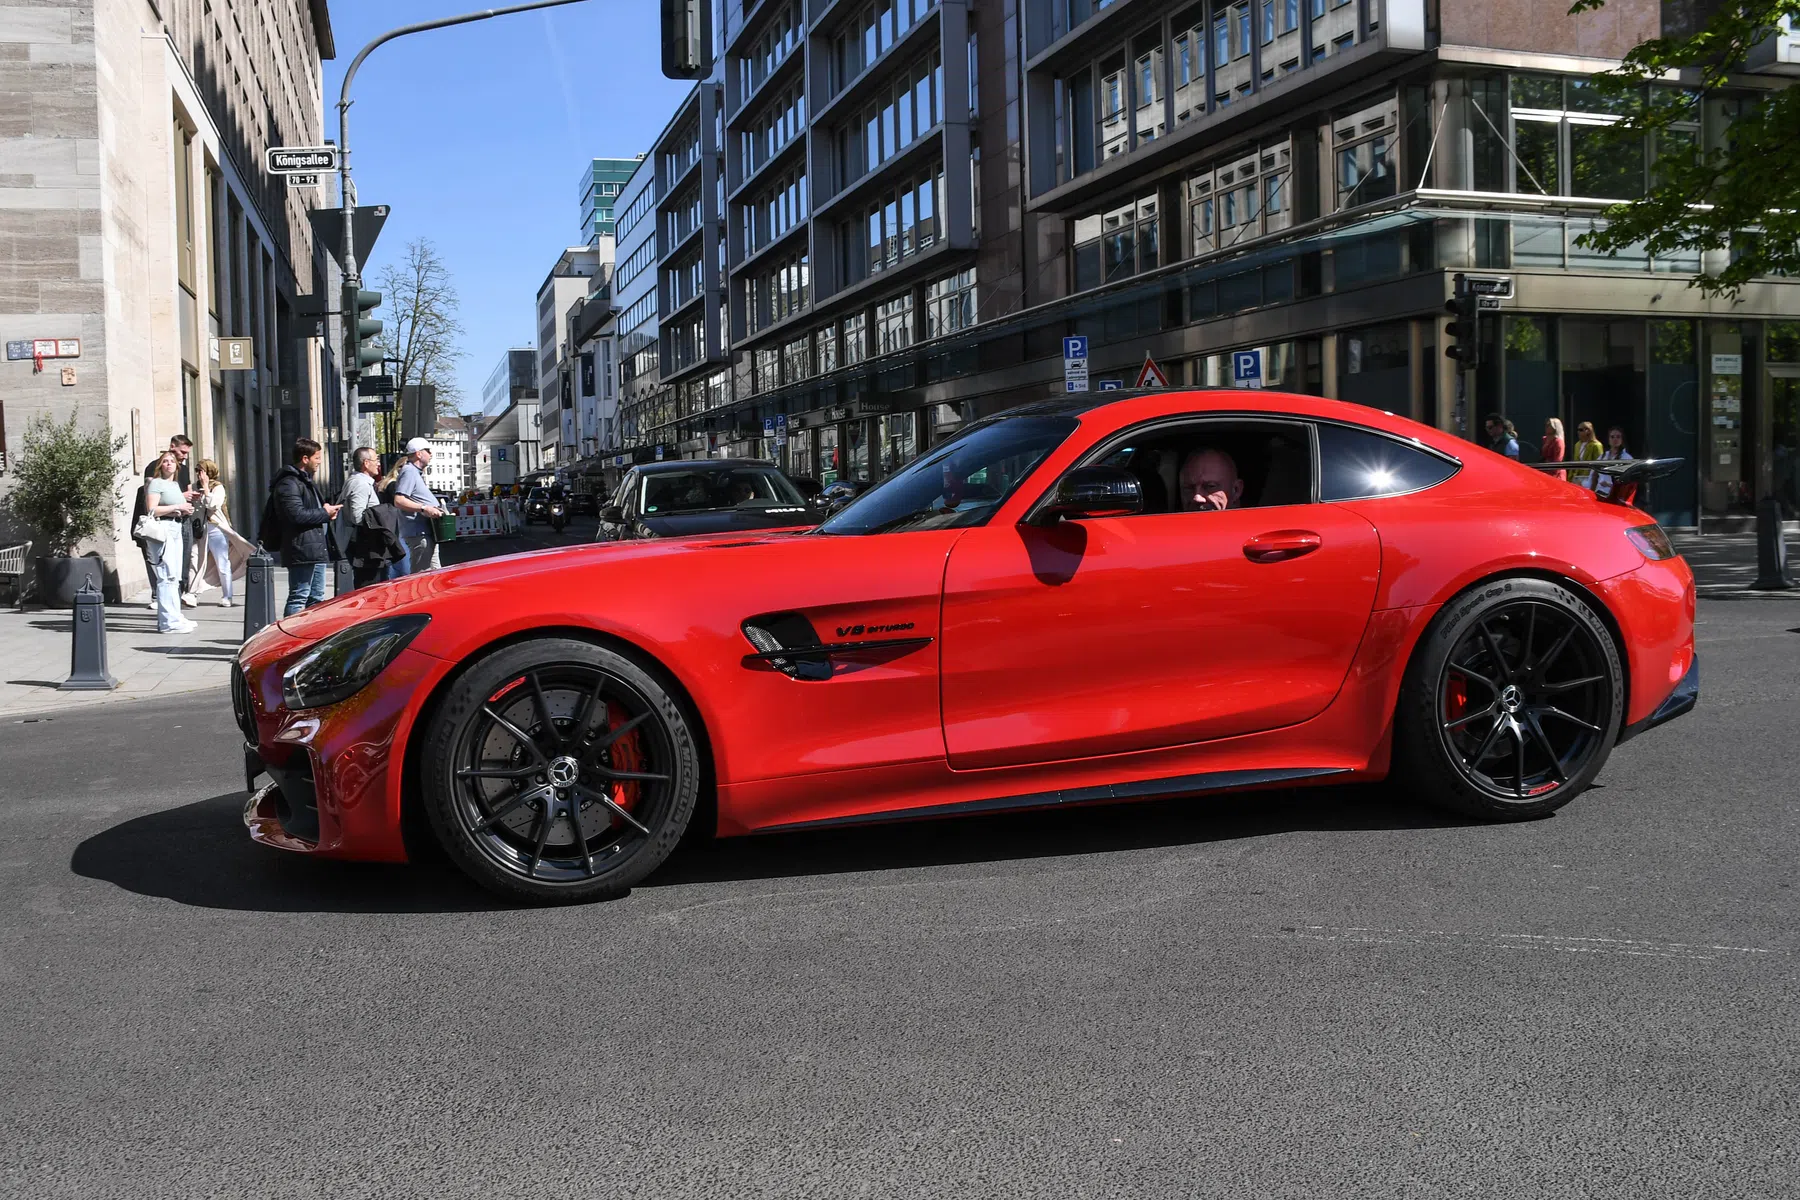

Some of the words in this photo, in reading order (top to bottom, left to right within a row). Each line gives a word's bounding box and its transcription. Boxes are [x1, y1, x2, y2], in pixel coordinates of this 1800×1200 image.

[275, 154, 329, 168] Königsallee
[1068, 339, 1082, 358] P
[1239, 354, 1255, 378] P
[861, 402, 890, 411] House
[765, 418, 772, 429] P
[1441, 614, 1461, 639] Pilot
[1460, 594, 1485, 618] Sport
[1485, 587, 1504, 598] Cup
[836, 624, 866, 637] V8
[867, 622, 915, 634] BITURBO
[1590, 616, 1621, 681] MICHELIN
[672, 746, 692, 823] MICHELIN
